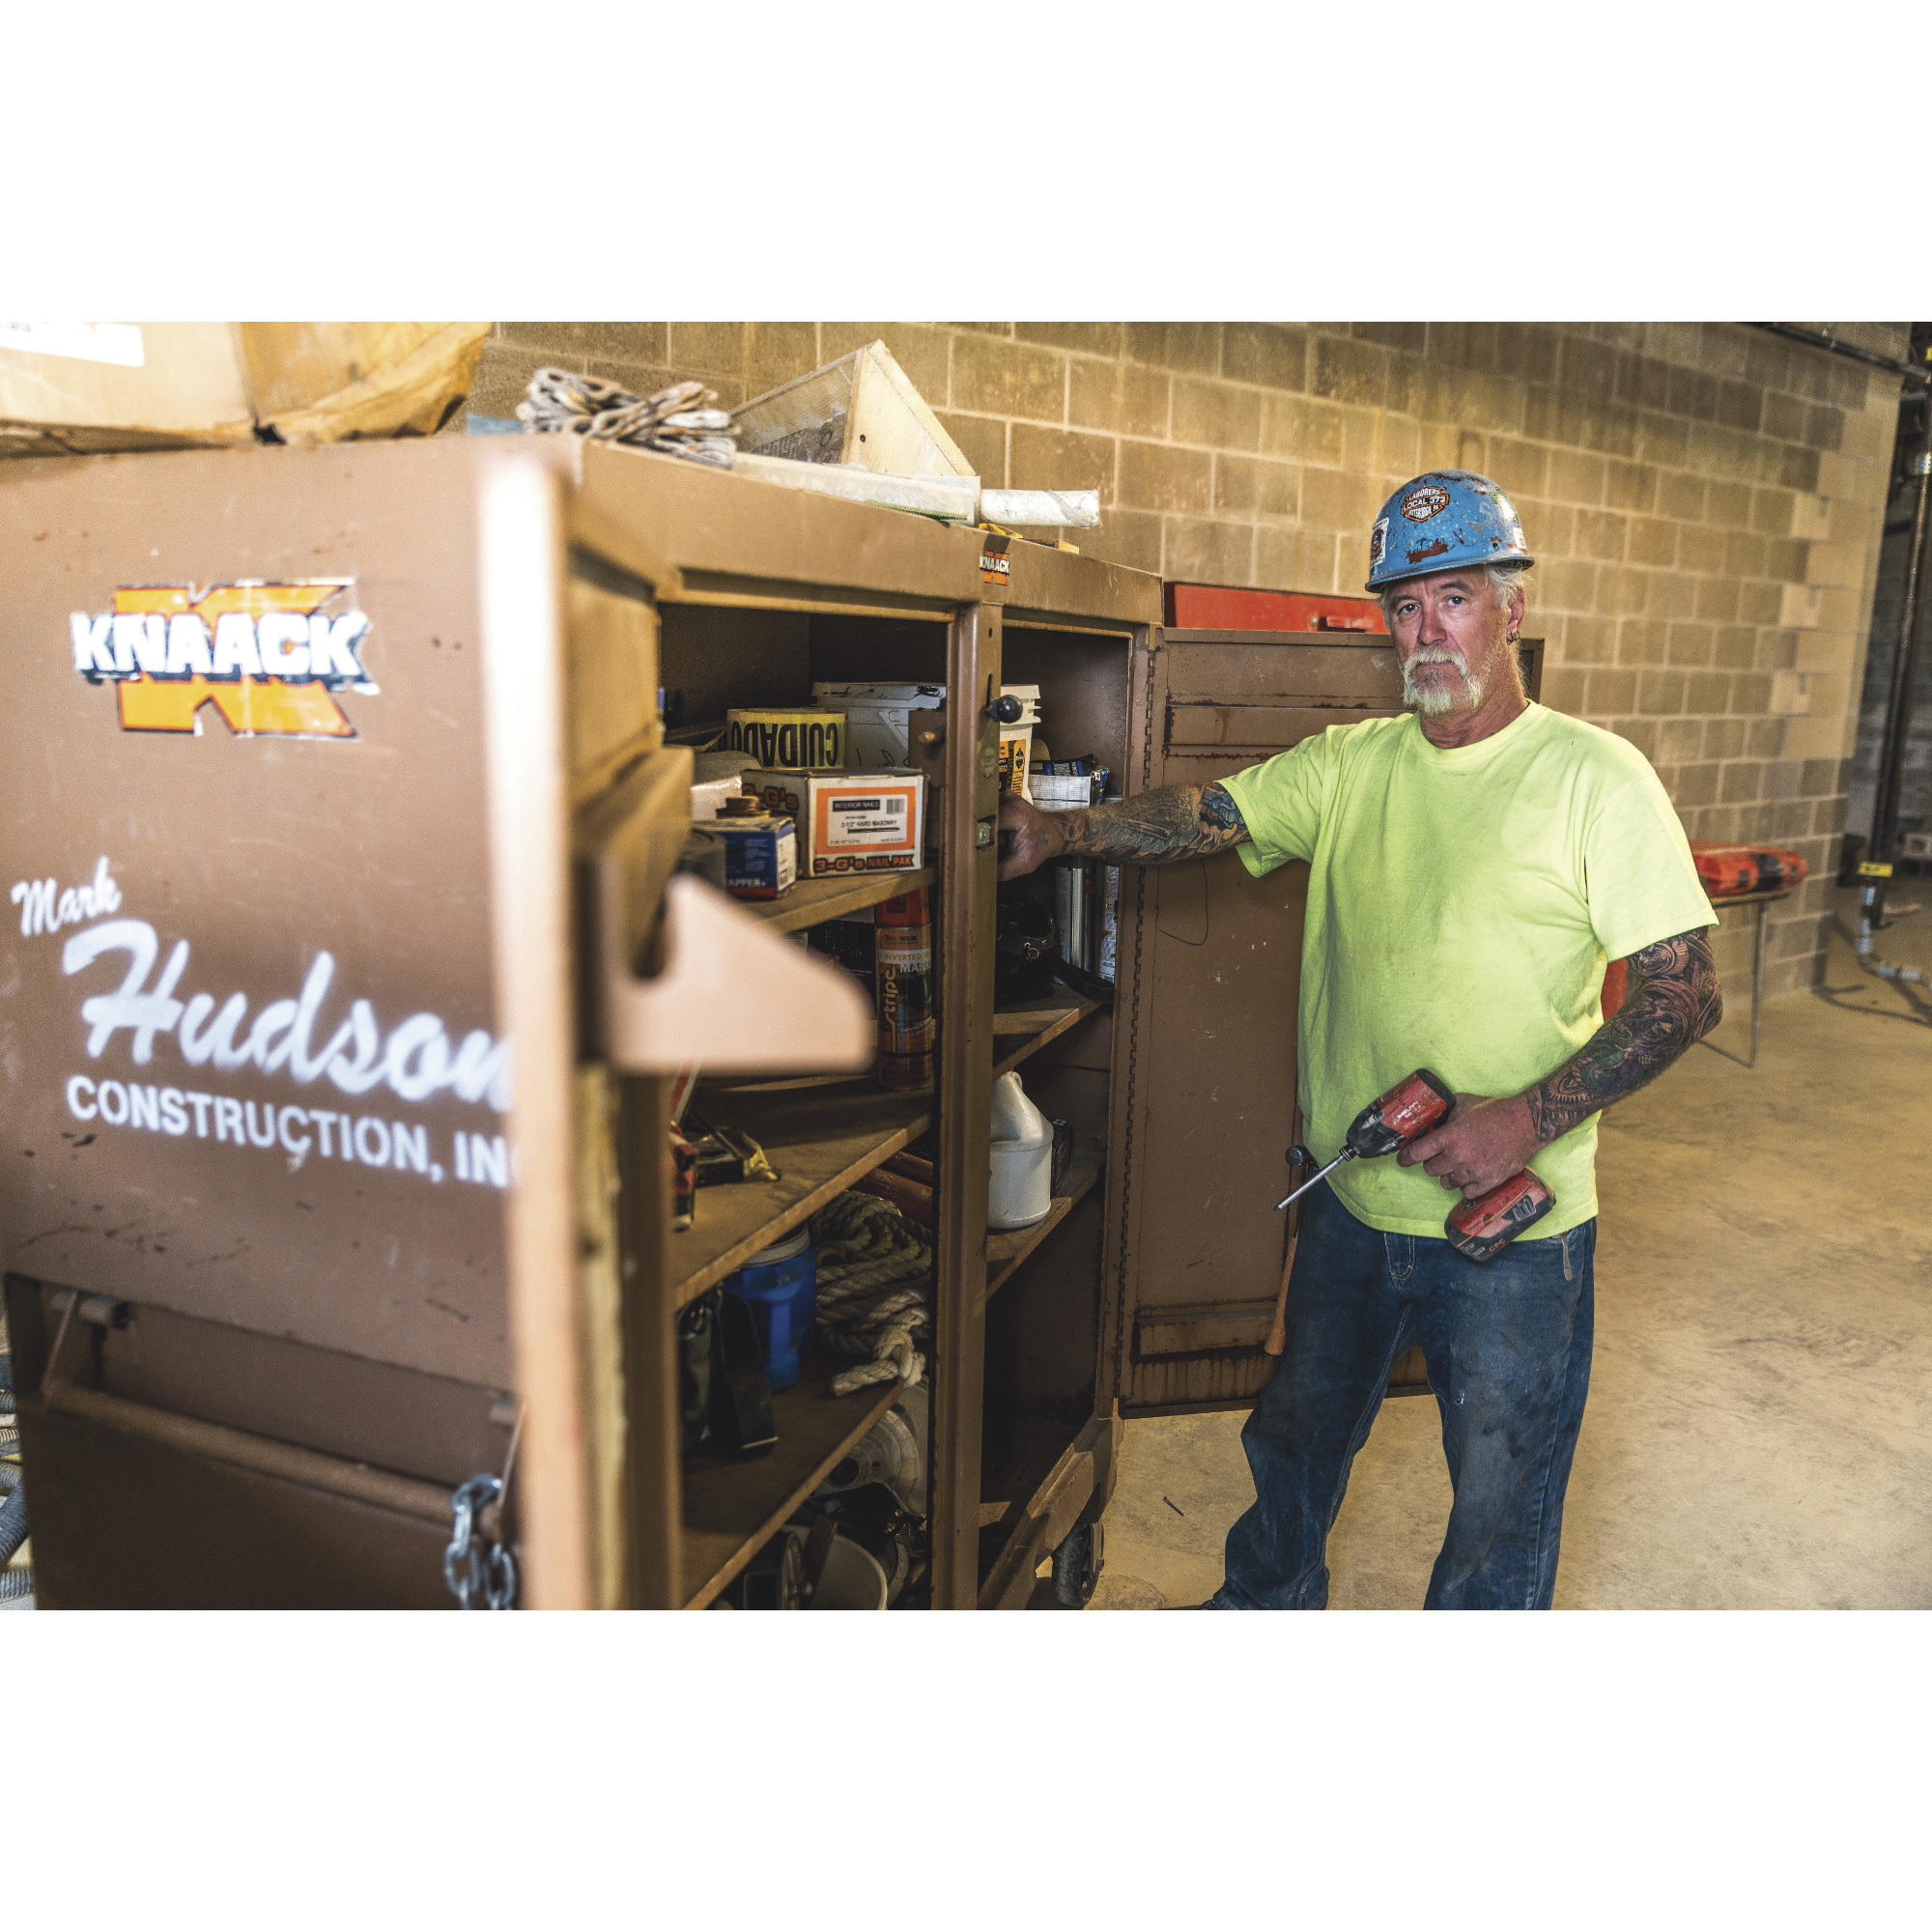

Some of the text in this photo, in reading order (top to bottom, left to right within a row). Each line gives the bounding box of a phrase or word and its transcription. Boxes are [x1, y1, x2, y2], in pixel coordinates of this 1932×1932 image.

[1403, 497, 1427, 511] LOCAL
[1408, 488, 1440, 500] LABORERS
[979, 555, 1010, 574] KNAACK
[71, 611, 371, 682] KNAACK
[731, 721, 838, 767] CUIDADO
[835, 801, 862, 810] INTERIOR
[814, 855, 914, 872] 3-G's NAIL PAK
[11, 855, 122, 937] Mark
[63, 919, 515, 1112] Hudson
[66, 1075, 519, 1189] CONSTRUCTION, IN
